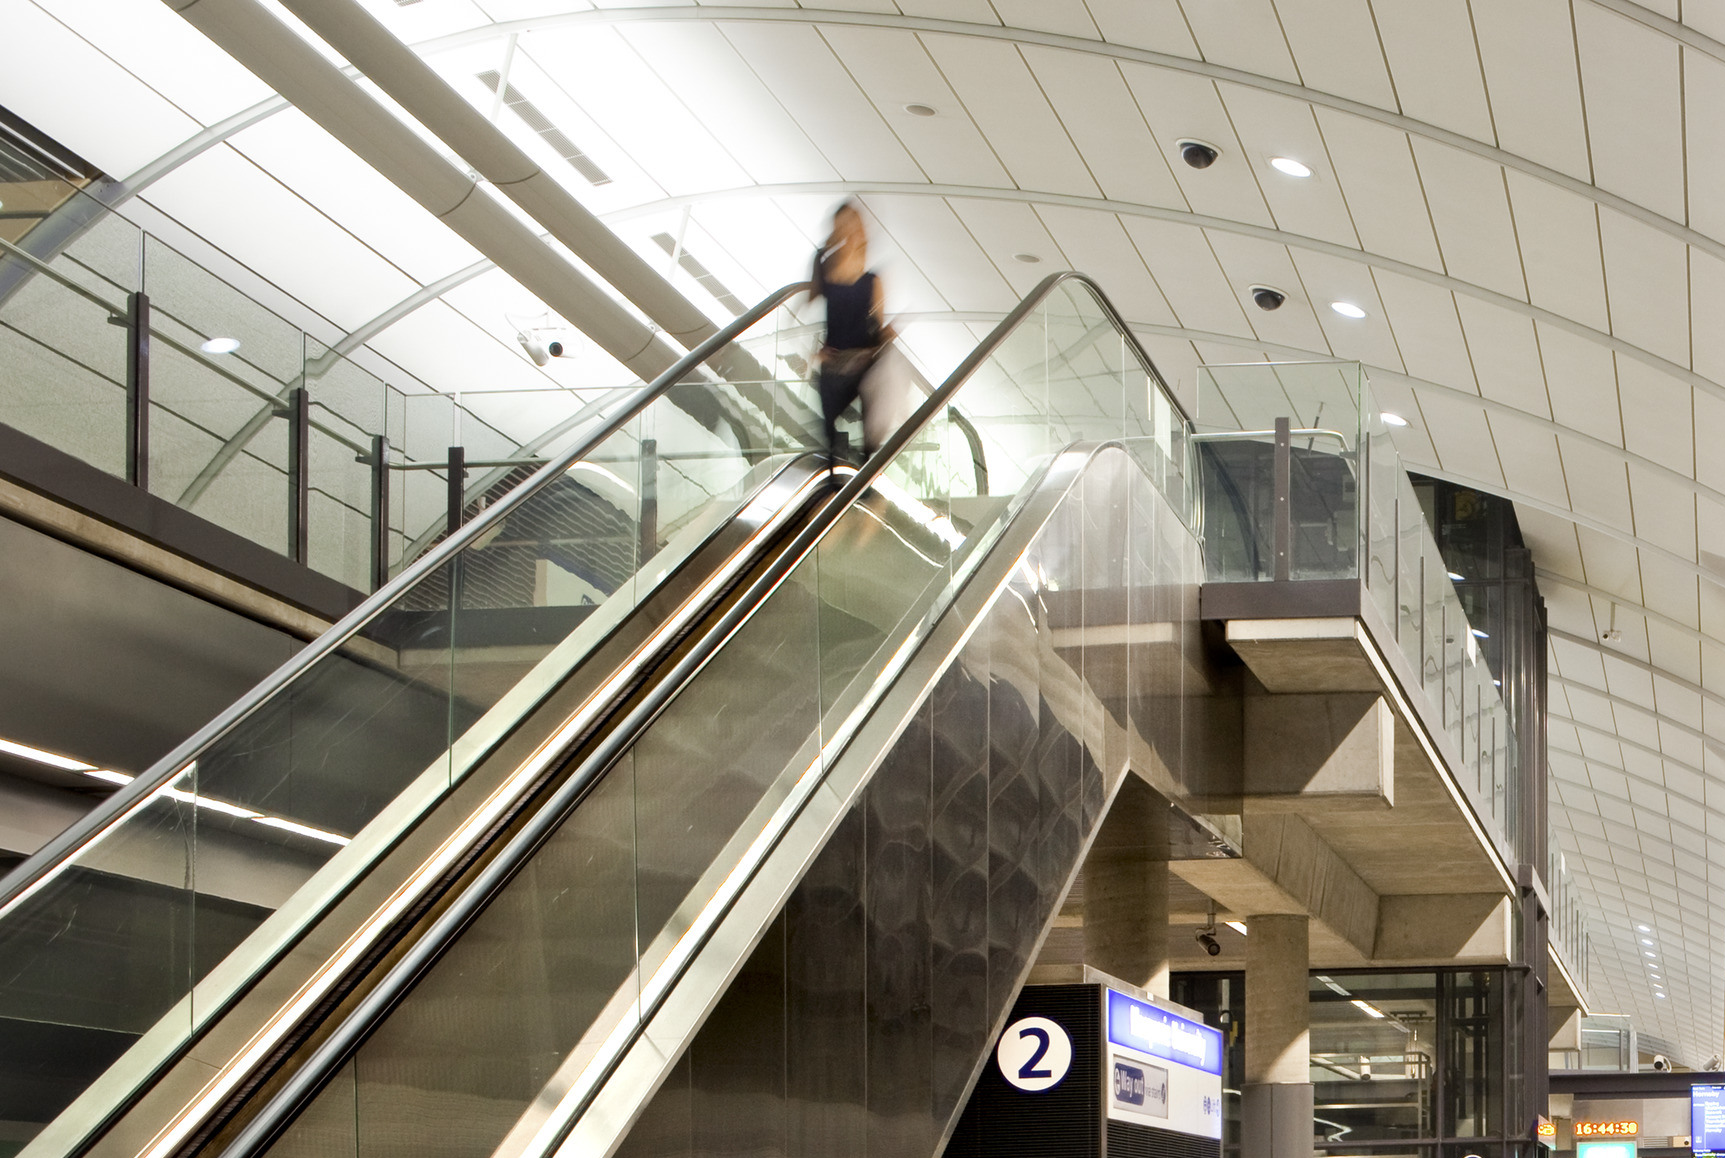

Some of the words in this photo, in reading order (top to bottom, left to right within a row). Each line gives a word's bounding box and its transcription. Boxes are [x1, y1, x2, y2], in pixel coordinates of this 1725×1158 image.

[1018, 1028, 1052, 1079] 2
[1120, 1069, 1134, 1098] Way
[1134, 1076, 1144, 1096] out
